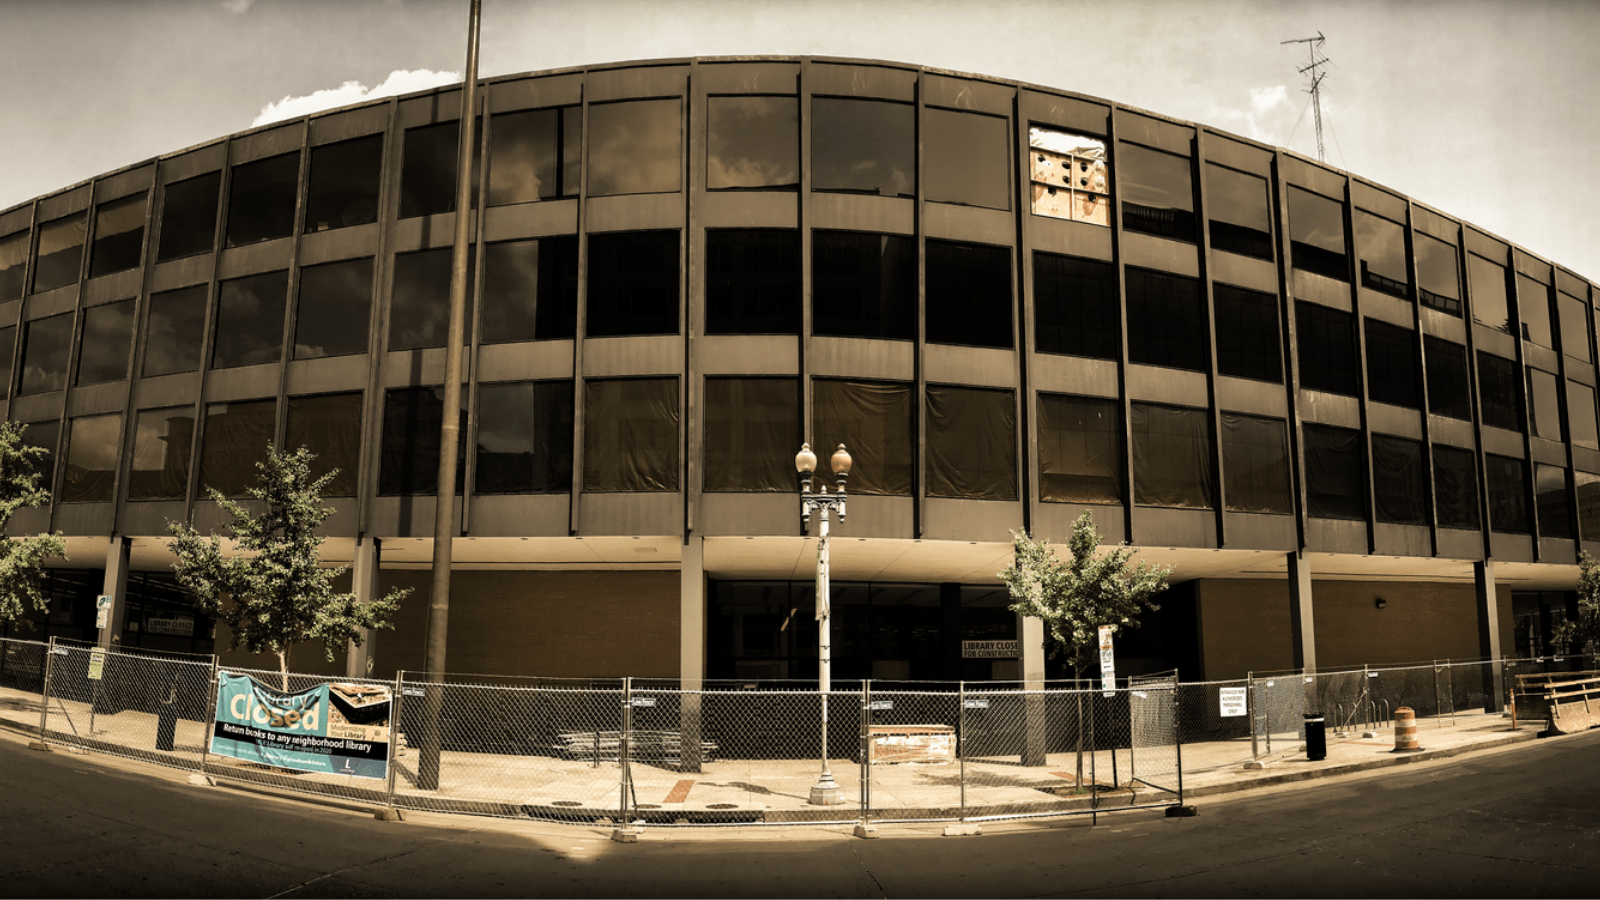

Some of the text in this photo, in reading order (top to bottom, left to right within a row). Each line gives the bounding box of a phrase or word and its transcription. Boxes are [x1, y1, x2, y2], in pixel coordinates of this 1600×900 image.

[149, 619, 193, 629] LIBRARY CLOSED
[963, 642, 995, 650] LIBRARY
[230, 693, 320, 731] Closed
[223, 723, 372, 753] Return books to any neighborhood library
[344, 731, 367, 740] Library
